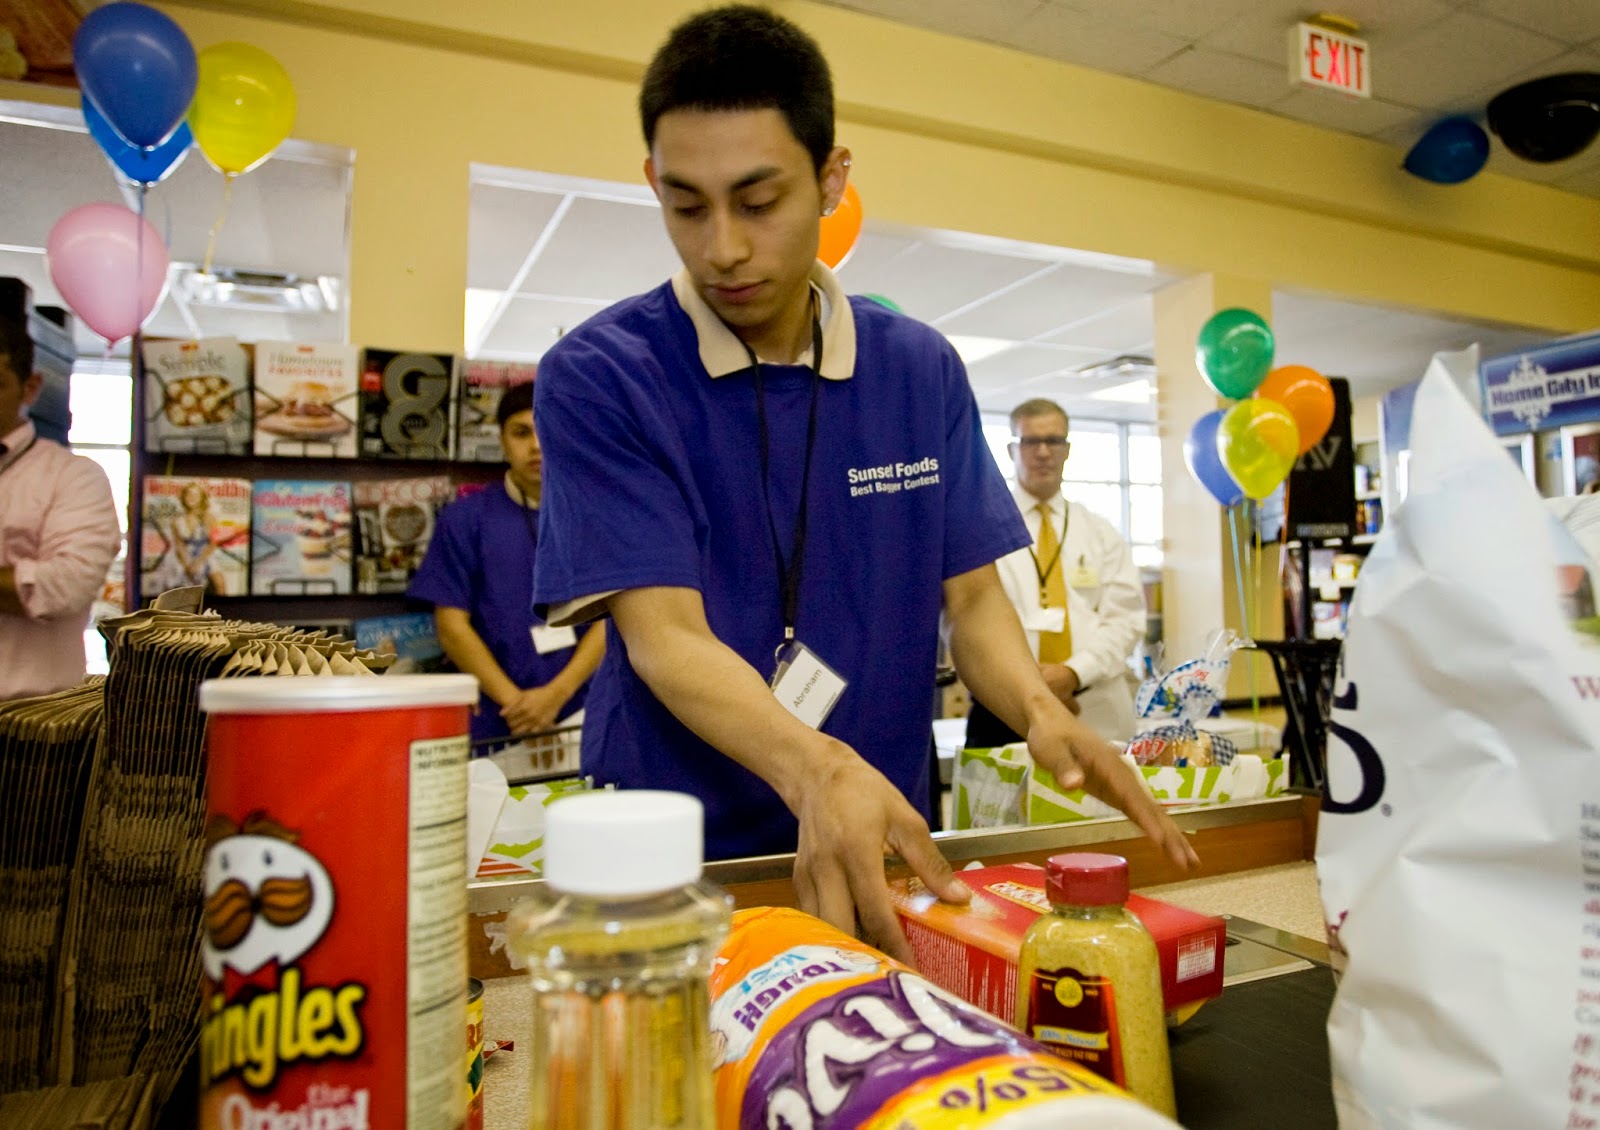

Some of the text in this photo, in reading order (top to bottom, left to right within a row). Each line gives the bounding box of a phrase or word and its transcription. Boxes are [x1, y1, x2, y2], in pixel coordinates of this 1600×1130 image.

[1309, 32, 1365, 91] EXIT
[1492, 385, 1544, 405] Home
[1547, 377, 1585, 397] City
[847, 457, 939, 484] Sunset Foods
[850, 473, 940, 497] Best Bagger Contest
[793, 668, 823, 709] Abraham
[733, 960, 853, 1033] TOUGH
